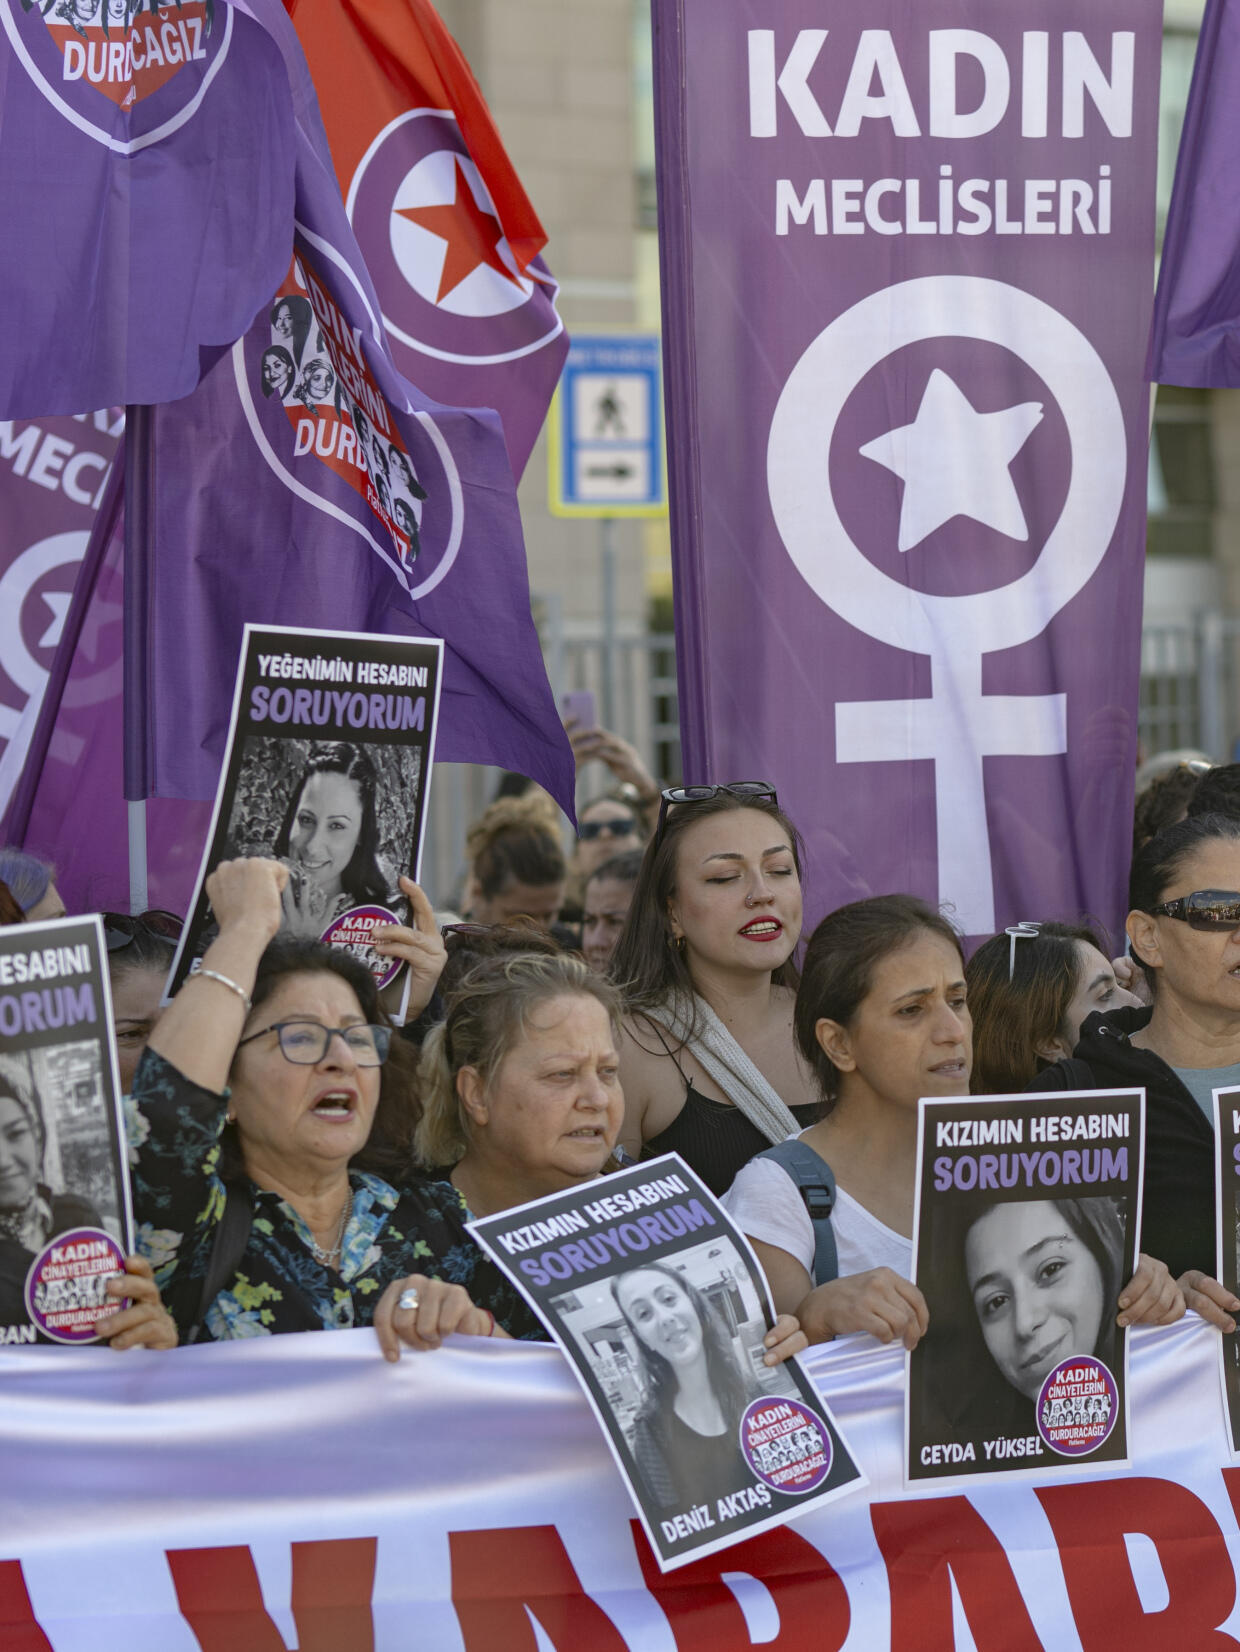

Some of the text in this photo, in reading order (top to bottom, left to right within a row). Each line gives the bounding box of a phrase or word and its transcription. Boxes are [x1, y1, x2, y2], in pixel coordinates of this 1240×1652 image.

[748, 29, 1135, 138] KADIN
[775, 164, 1111, 235] MECLİSLERİ
[258, 652, 428, 688] YEĞENİMİN HESABINI
[250, 685, 426, 732] SORUYORUM
[936, 1113, 1130, 1148] KIZIMIN HESABINI
[933, 1146, 1128, 1191] SORUYORUM
[497, 1174, 690, 1256] KIZIMIN HESABINI
[51, 1240, 108, 1265] KADIN
[519, 1199, 716, 1288] SORUYORUM
[1048, 1378, 1105, 1398] CİNAYETLERİNİ
[1056, 1367, 1099, 1384] KADIN
[747, 1403, 793, 1430] KADIN
[1050, 1424, 1104, 1441] DURDURACAĞIZ
[920, 1436, 1043, 1466] CEYDA YÜKSEL
[660, 1482, 772, 1544] DENİZ AKTAŞ
